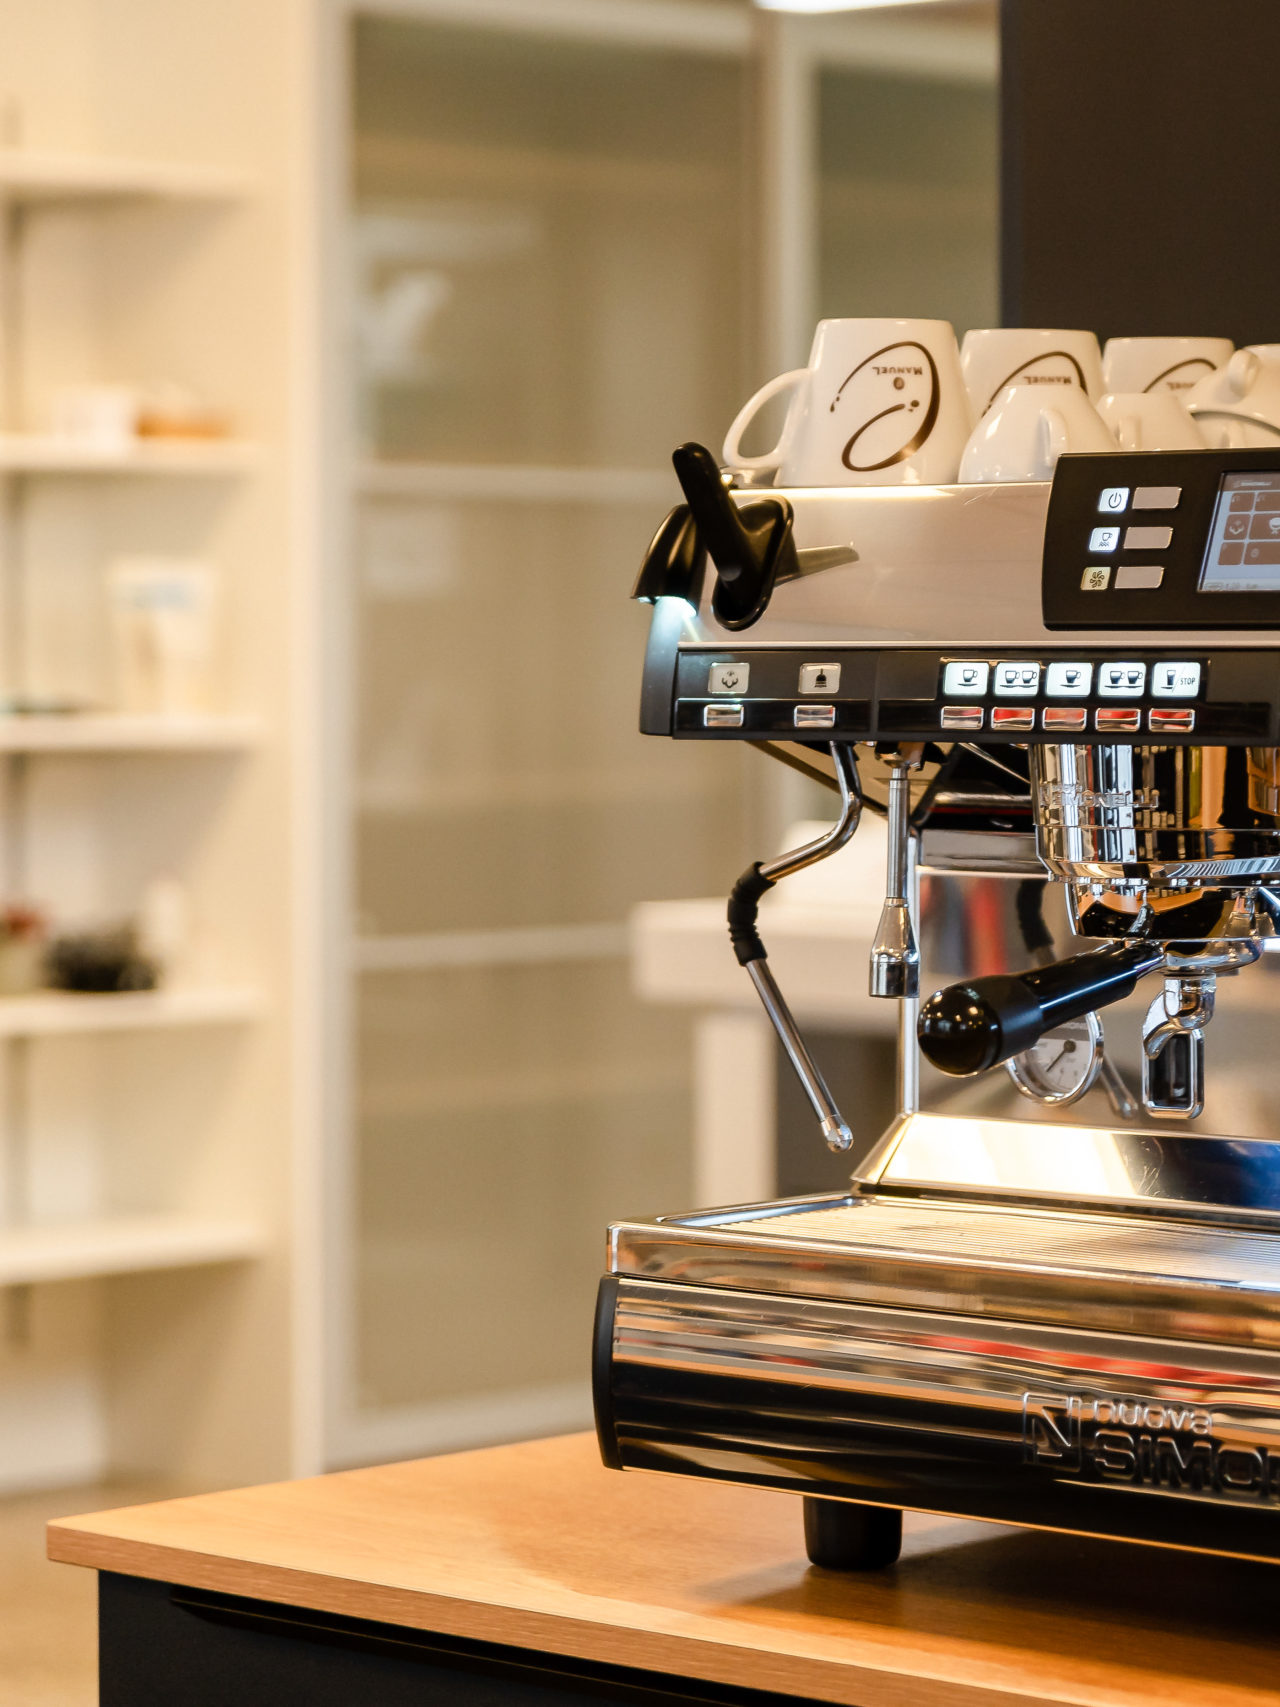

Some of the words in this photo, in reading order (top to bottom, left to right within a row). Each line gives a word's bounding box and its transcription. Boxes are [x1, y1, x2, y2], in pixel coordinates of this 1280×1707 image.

[872, 366, 923, 376] MANUEL
[1180, 677, 1196, 686] STOP
[1093, 1399, 1213, 1435] nuova
